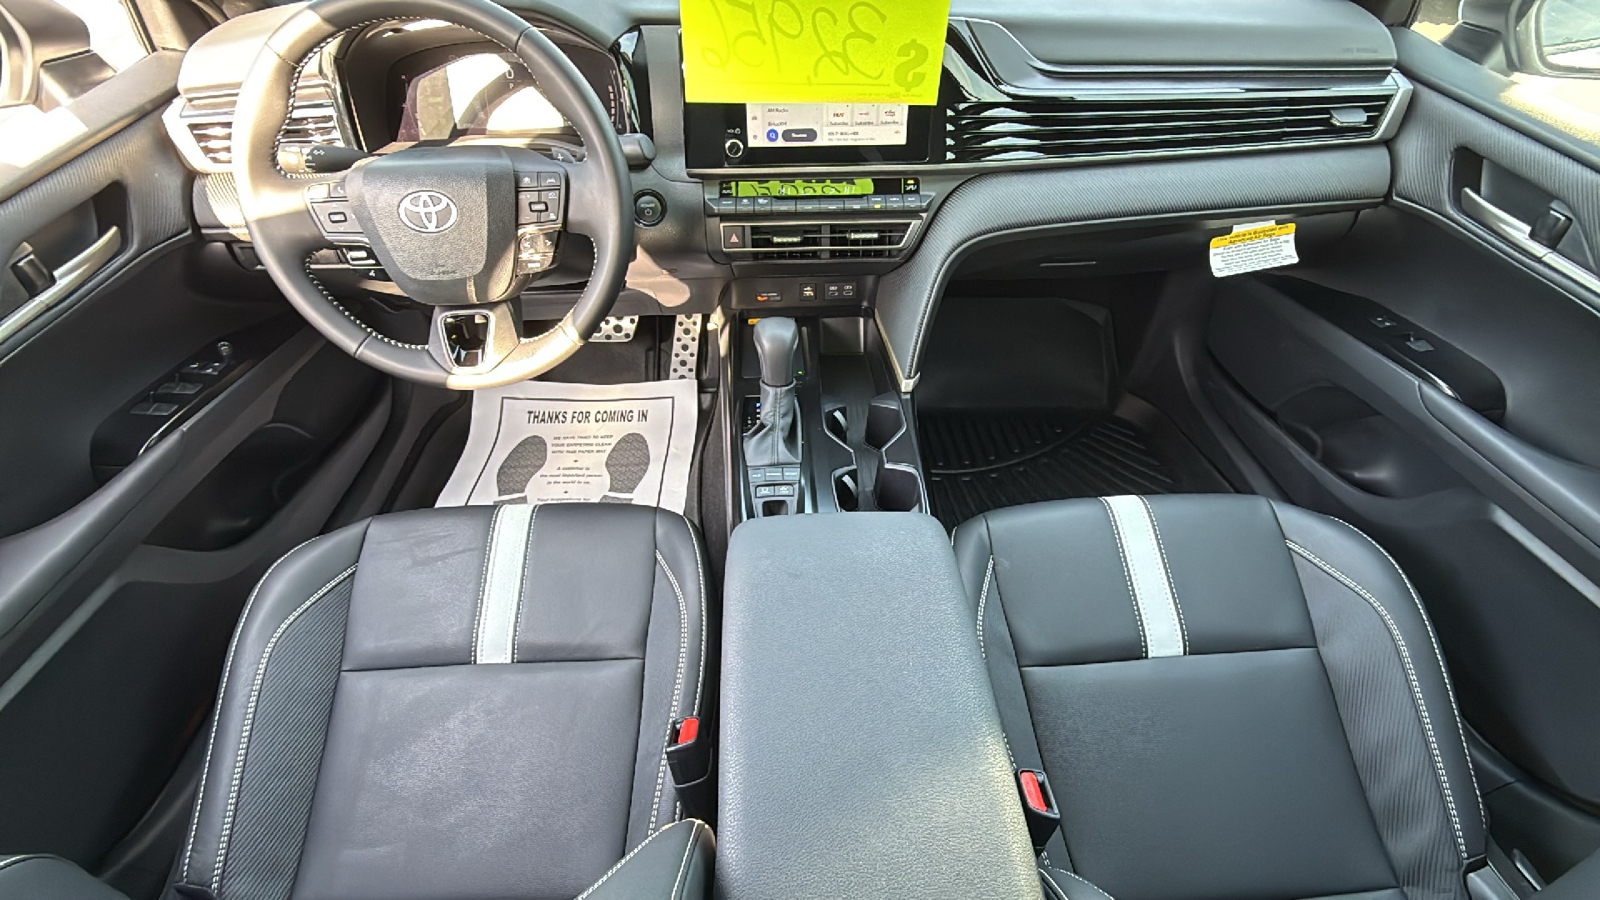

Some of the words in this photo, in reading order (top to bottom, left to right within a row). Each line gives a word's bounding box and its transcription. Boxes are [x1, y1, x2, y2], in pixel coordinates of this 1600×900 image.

[527, 410, 568, 424] THANKS
[570, 410, 591, 424] FOR
[594, 409, 634, 423] COMING
[637, 409, 649, 423] IN
